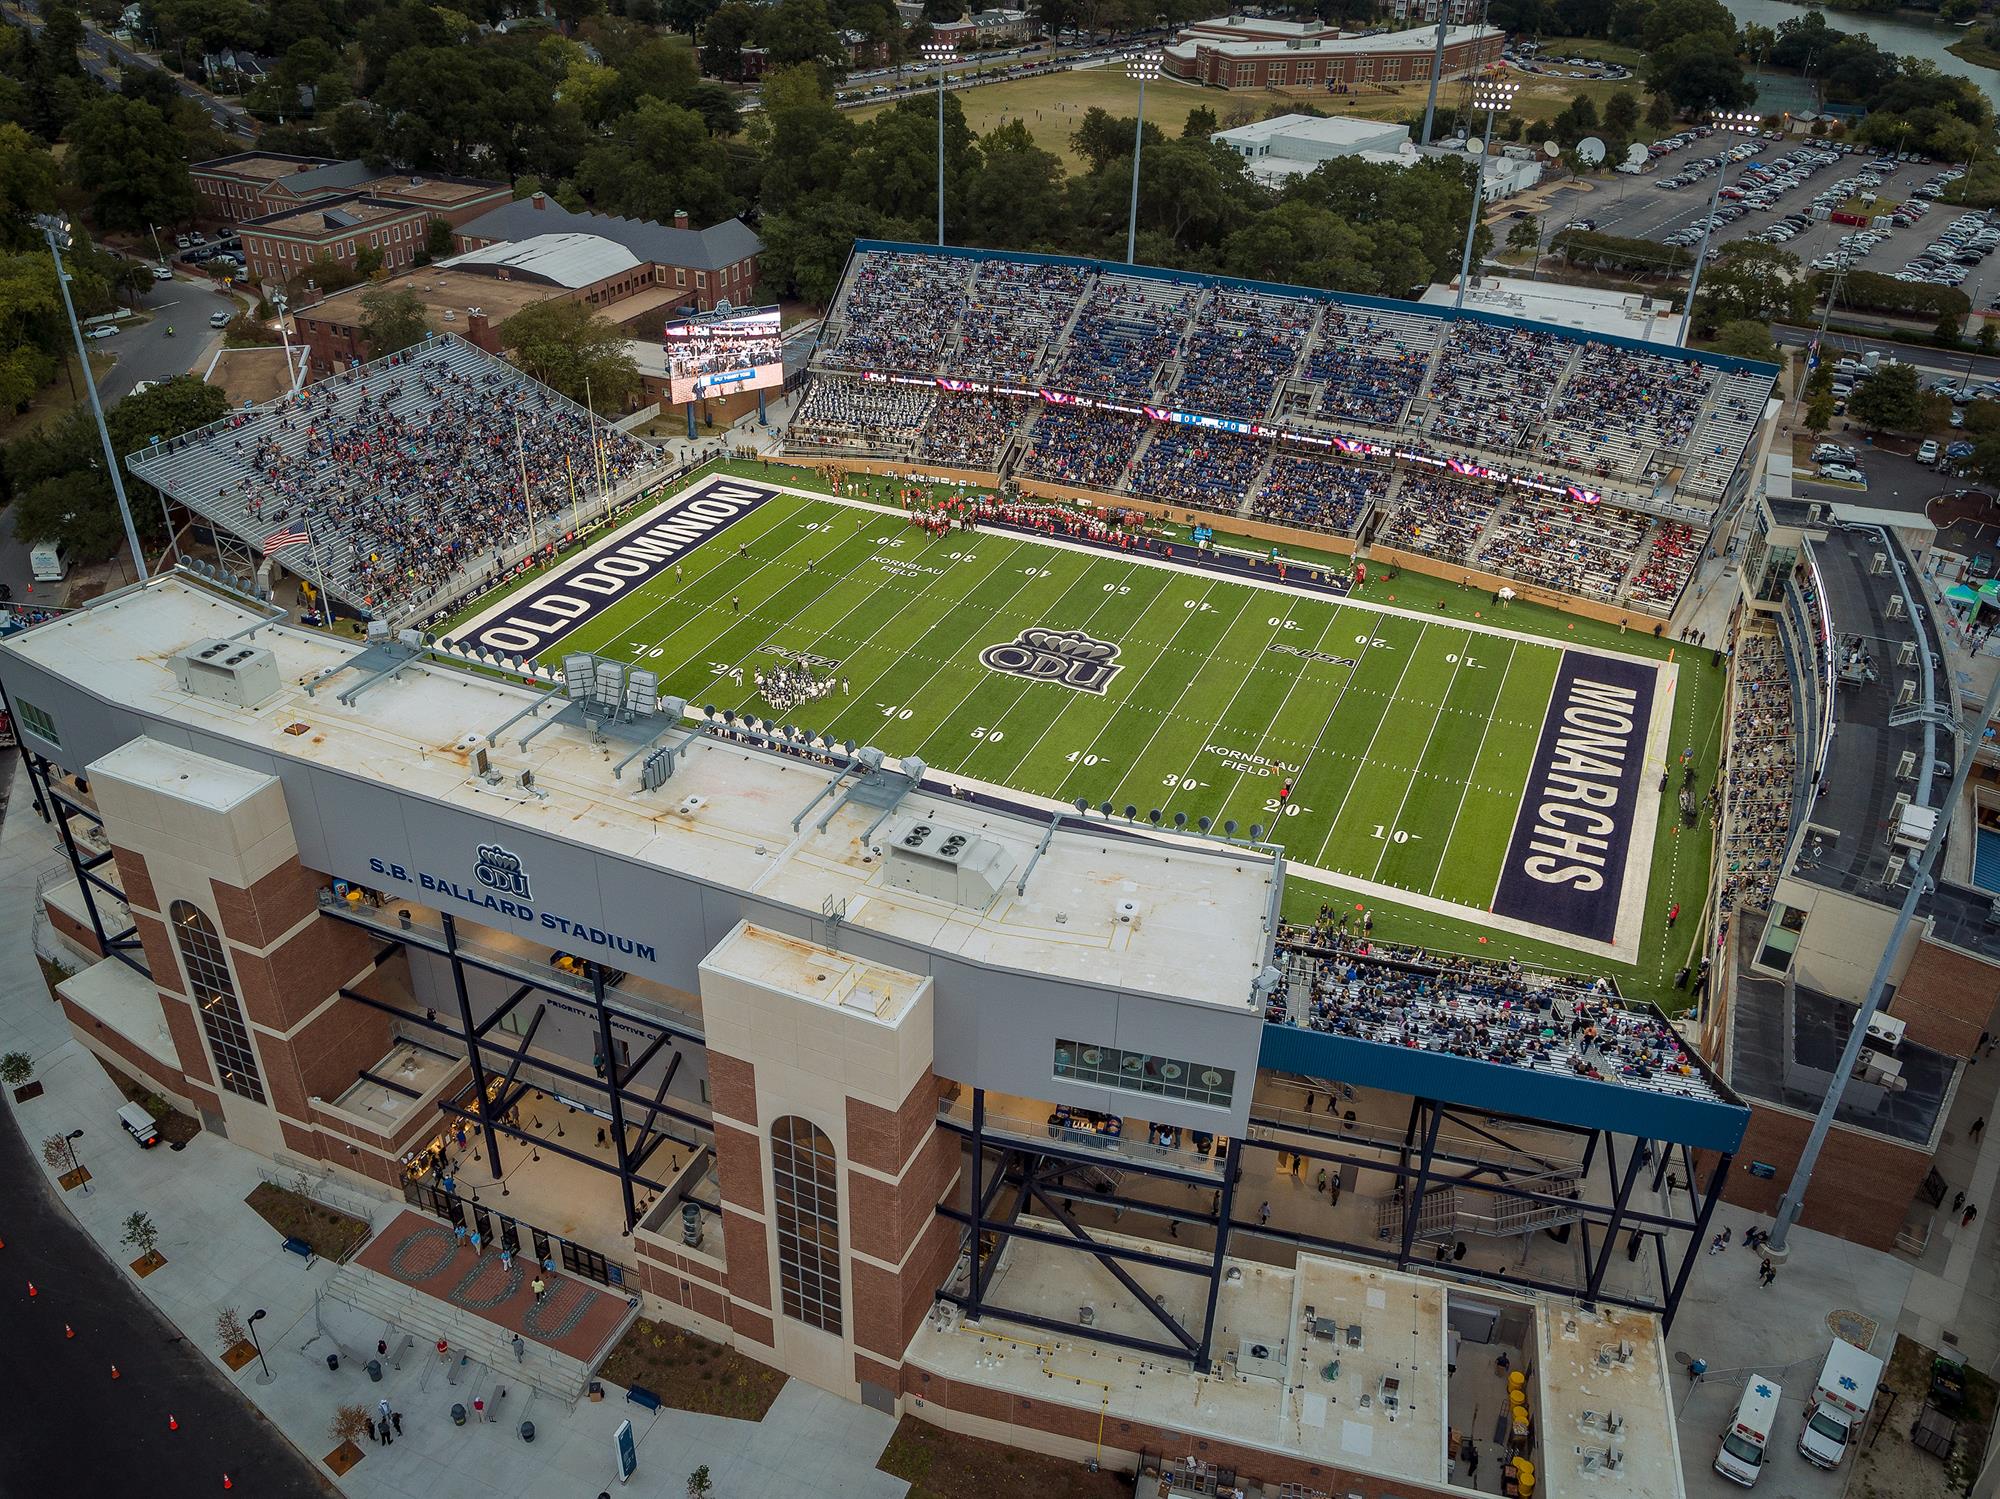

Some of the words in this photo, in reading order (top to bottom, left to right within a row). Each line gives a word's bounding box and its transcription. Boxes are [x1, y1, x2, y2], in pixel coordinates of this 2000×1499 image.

[804, 520, 833, 533] 10
[877, 537, 905, 547] 20
[870, 555, 944, 575] KORNBLAU
[950, 552, 976, 562] 30
[481, 594, 591, 652] OLD
[567, 487, 764, 597] DOMINION
[880, 565, 918, 577] FIELD
[1028, 566, 1052, 578] 40
[1103, 582, 1132, 596] 50
[1184, 600, 1212, 611] 40
[1268, 616, 1297, 630] 30
[1354, 634, 1388, 648] 20
[631, 643, 664, 658] 10
[980, 643, 1125, 694] ODU
[1445, 653, 1477, 668] 10
[884, 704, 913, 721] 40
[970, 727, 1003, 742] 50
[1064, 750, 1099, 767] 40
[1204, 744, 1300, 772] KORNBLAU
[1221, 760, 1270, 777] FIELD
[1162, 774, 1198, 791] 30
[1524, 678, 1637, 892] MONARCHS
[1370, 825, 1409, 844] 10
[475, 863, 533, 901] ODU
[369, 857, 413, 884] S.B.
[420, 872, 533, 922] BALLARD
[541, 911, 656, 962] STADIUM
[546, 999, 586, 1017] PRIORITY
